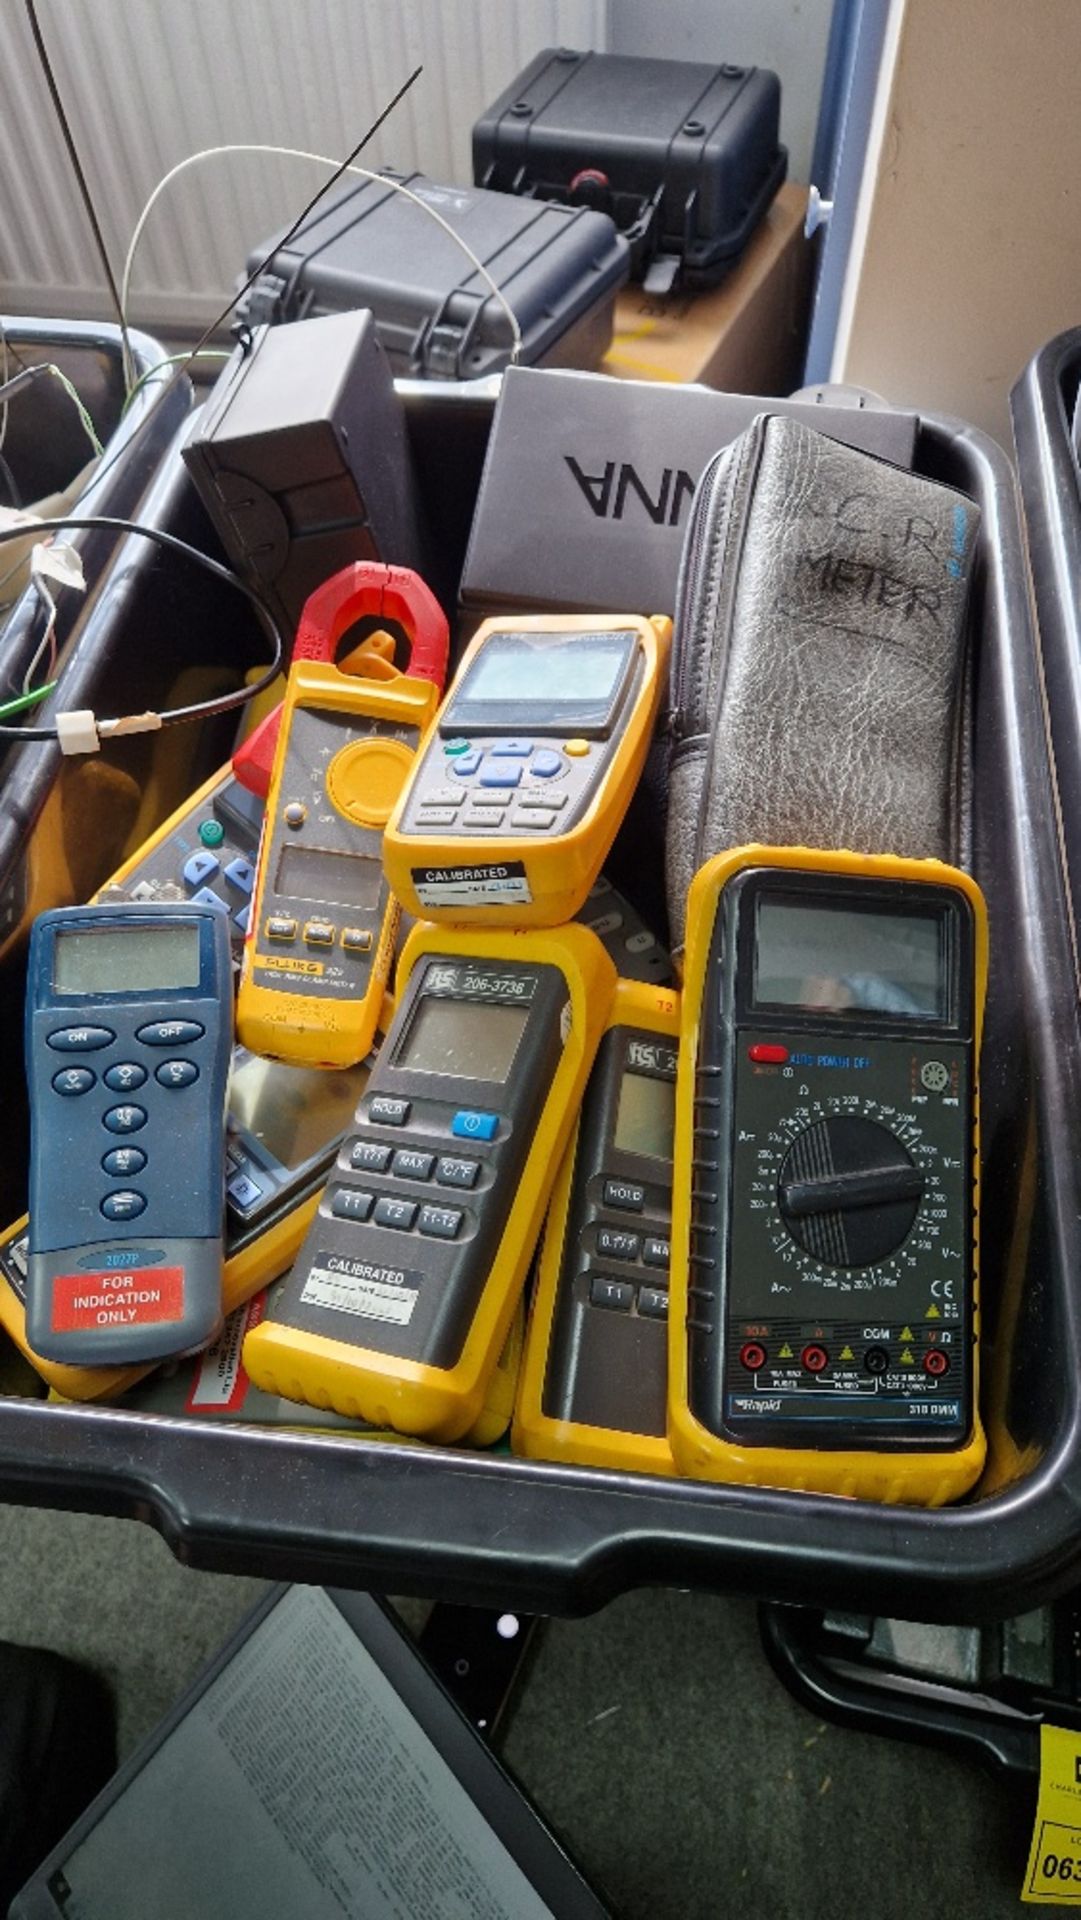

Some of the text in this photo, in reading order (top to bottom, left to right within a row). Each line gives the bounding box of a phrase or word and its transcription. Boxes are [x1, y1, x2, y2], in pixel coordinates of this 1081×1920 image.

[425, 867, 508, 882] CALIBRATED
[463, 976, 526, 995] 206-3736
[68, 1031, 88, 1042] ON
[158, 1026, 184, 1039] OFF
[372, 1101, 403, 1115] HOLD
[399, 1155, 426, 1169] MAX
[609, 1185, 642, 1201] HOLD
[344, 1194, 458, 1229] T1 T2 T1-T2
[327, 1257, 405, 1285] CALIBRATED
[102, 1275, 133, 1290] FOR
[73, 1290, 161, 1309] INDICATION
[606, 1285, 669, 1309] T1 T2
[96, 1309, 137, 1325] ONLY
